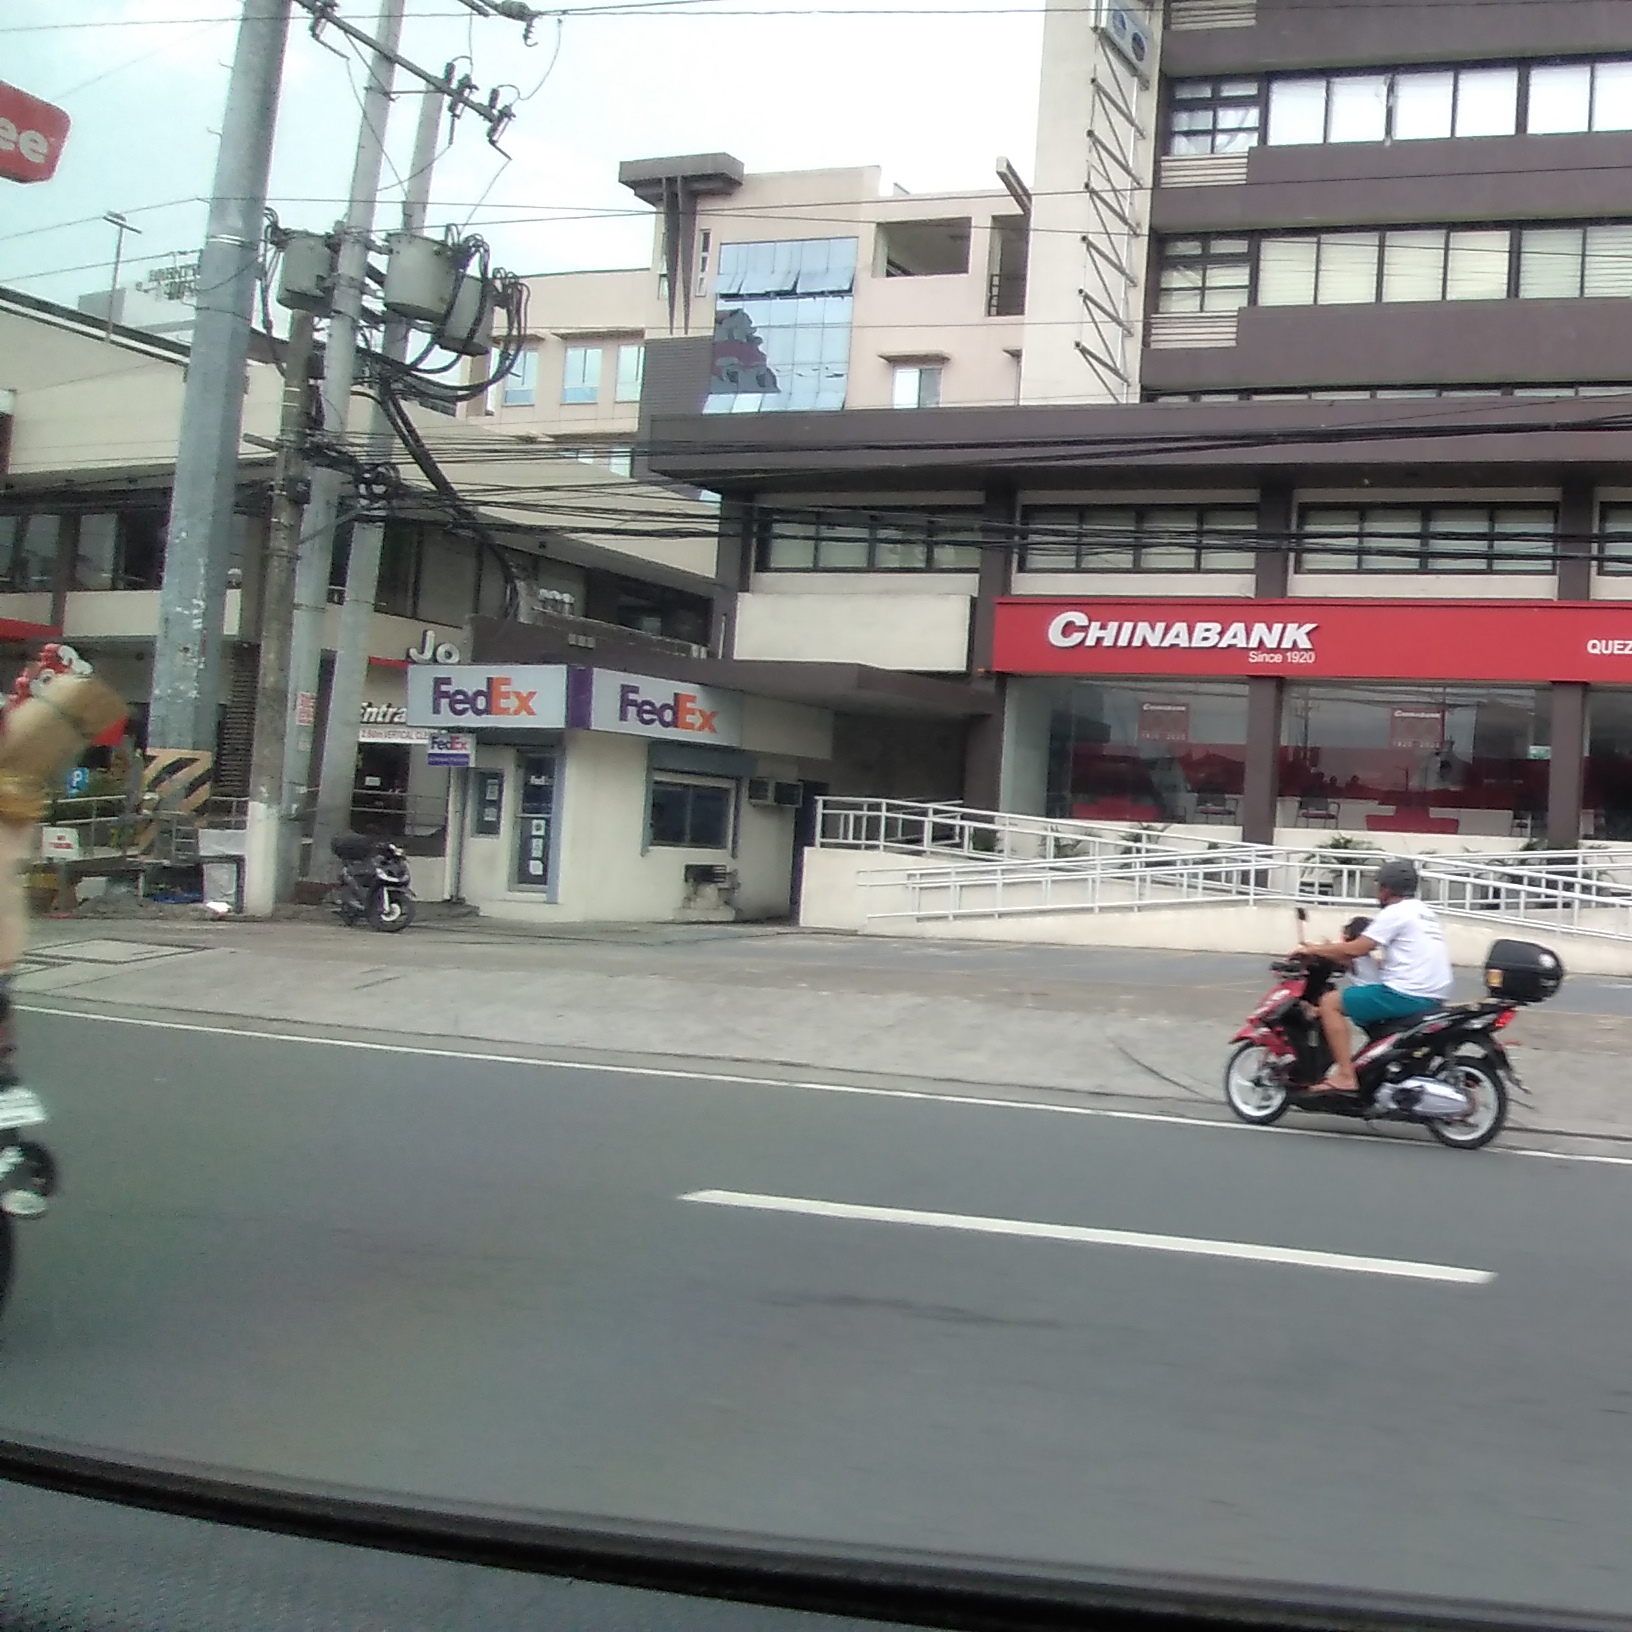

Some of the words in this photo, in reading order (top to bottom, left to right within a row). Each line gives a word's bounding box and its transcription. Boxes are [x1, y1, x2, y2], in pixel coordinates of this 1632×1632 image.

[1048, 611, 1318, 649] CHINABANK
[1248, 650, 1283, 663] Since
[1286, 651, 1315, 663] 1920
[432, 676, 538, 717] FedEx
[619, 683, 719, 734] FedEx
[431, 736, 468, 750] FedEx
